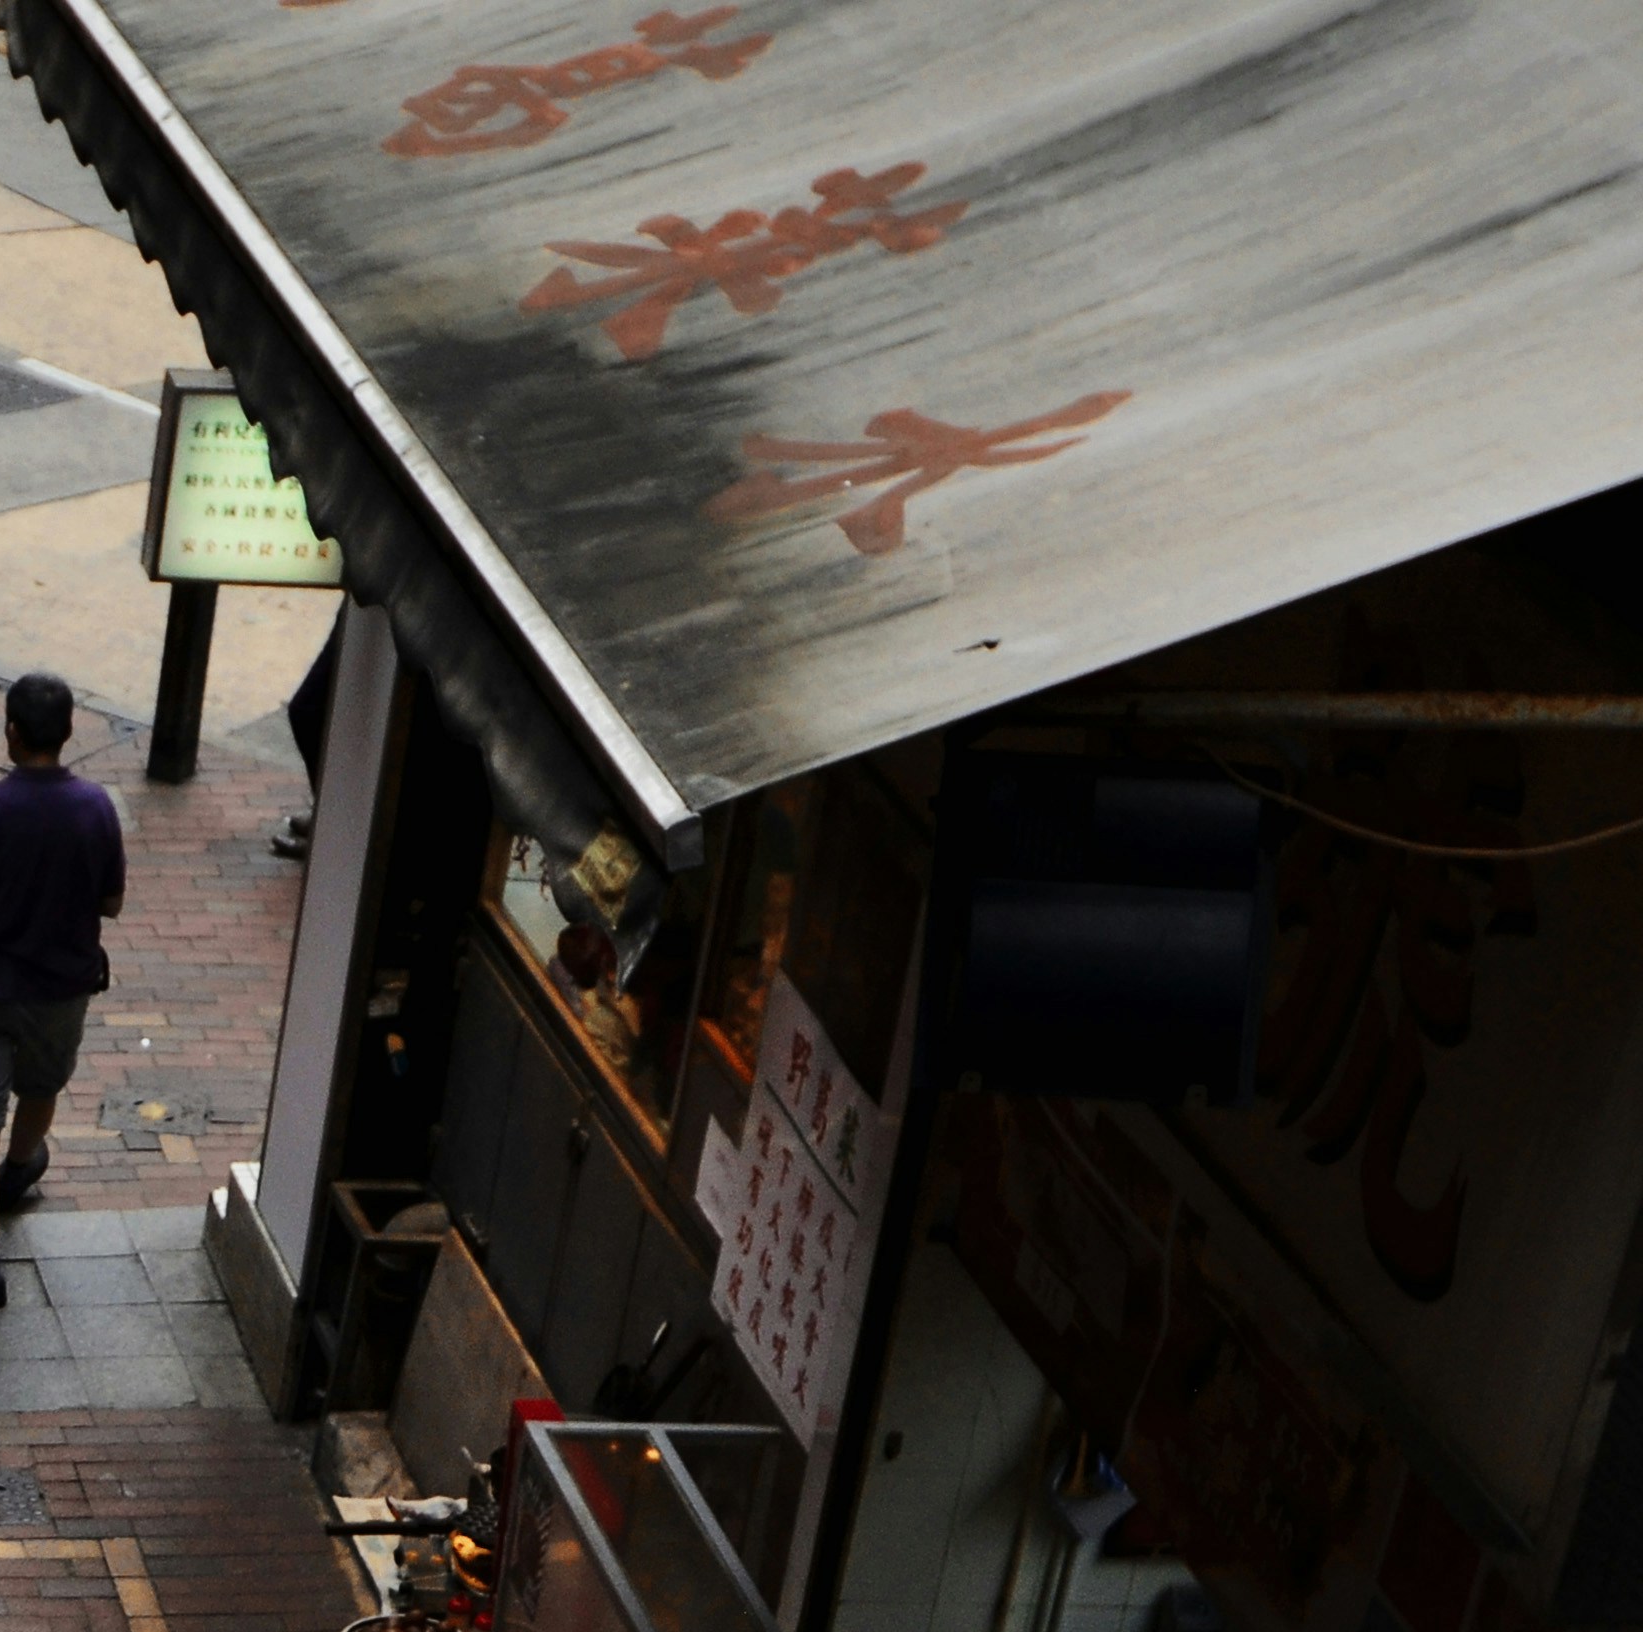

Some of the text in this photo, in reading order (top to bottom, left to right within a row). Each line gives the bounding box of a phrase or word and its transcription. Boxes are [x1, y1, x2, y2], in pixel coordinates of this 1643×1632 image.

[278, 0, 1133, 556] 葛菜水
[204, 504, 309, 521] 各國貨幣兌
